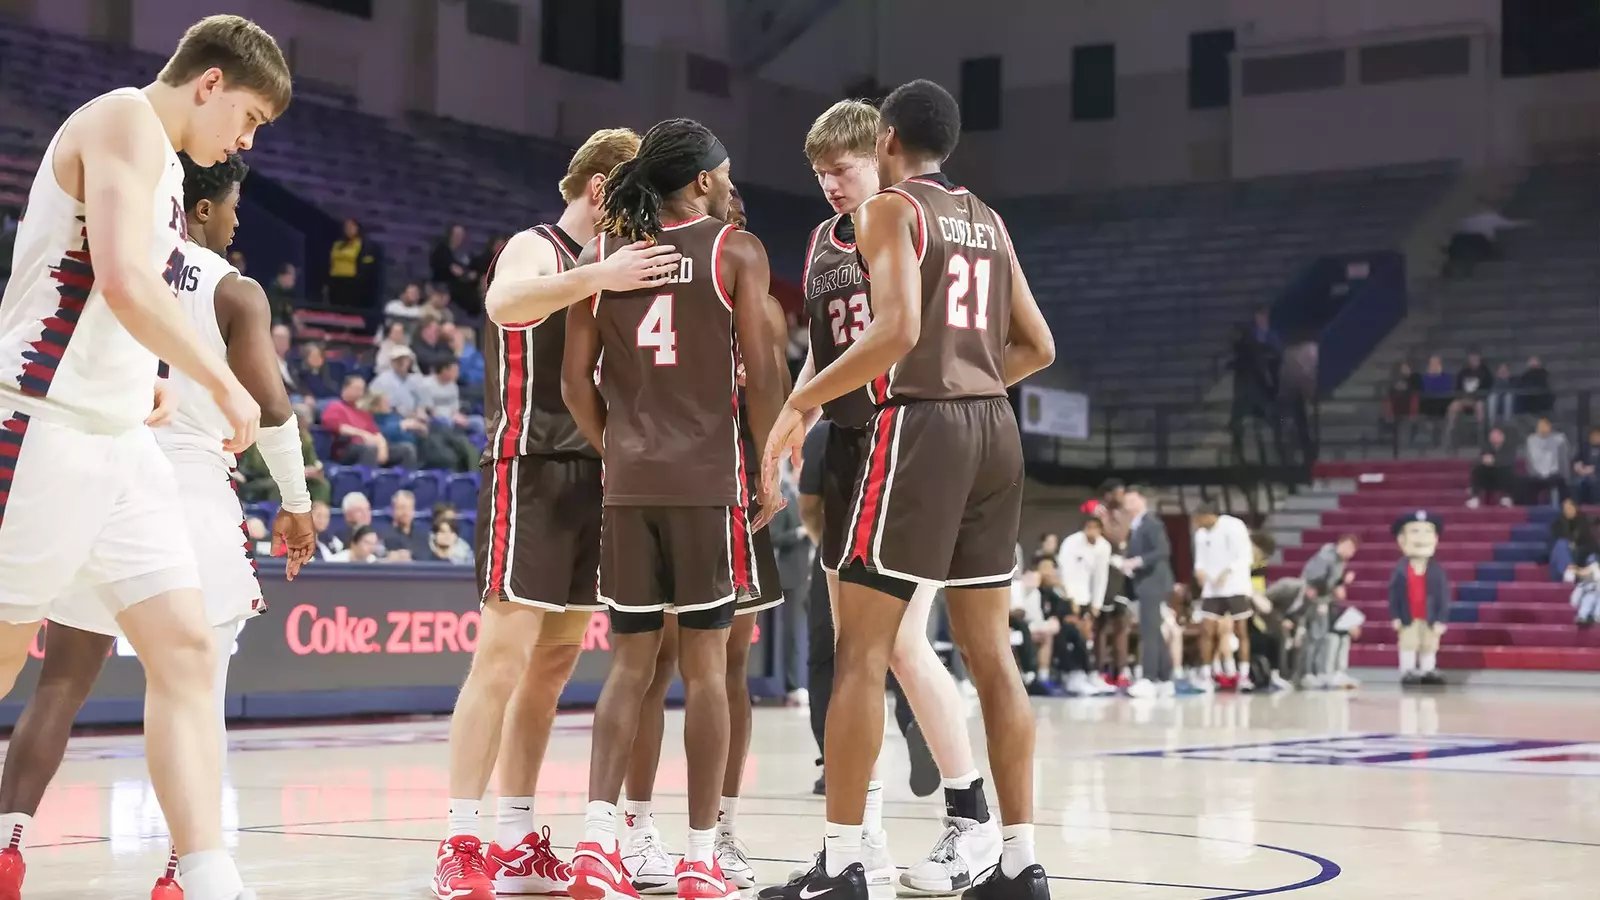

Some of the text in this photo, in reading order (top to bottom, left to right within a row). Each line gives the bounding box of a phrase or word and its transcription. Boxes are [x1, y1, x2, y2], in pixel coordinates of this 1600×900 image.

[938, 216, 997, 251] COOLEY
[810, 262, 863, 300] BRO
[946, 253, 991, 331] 21
[636, 293, 678, 366] 4
[828, 291, 872, 347] 23
[385, 610, 482, 654] ZERO
